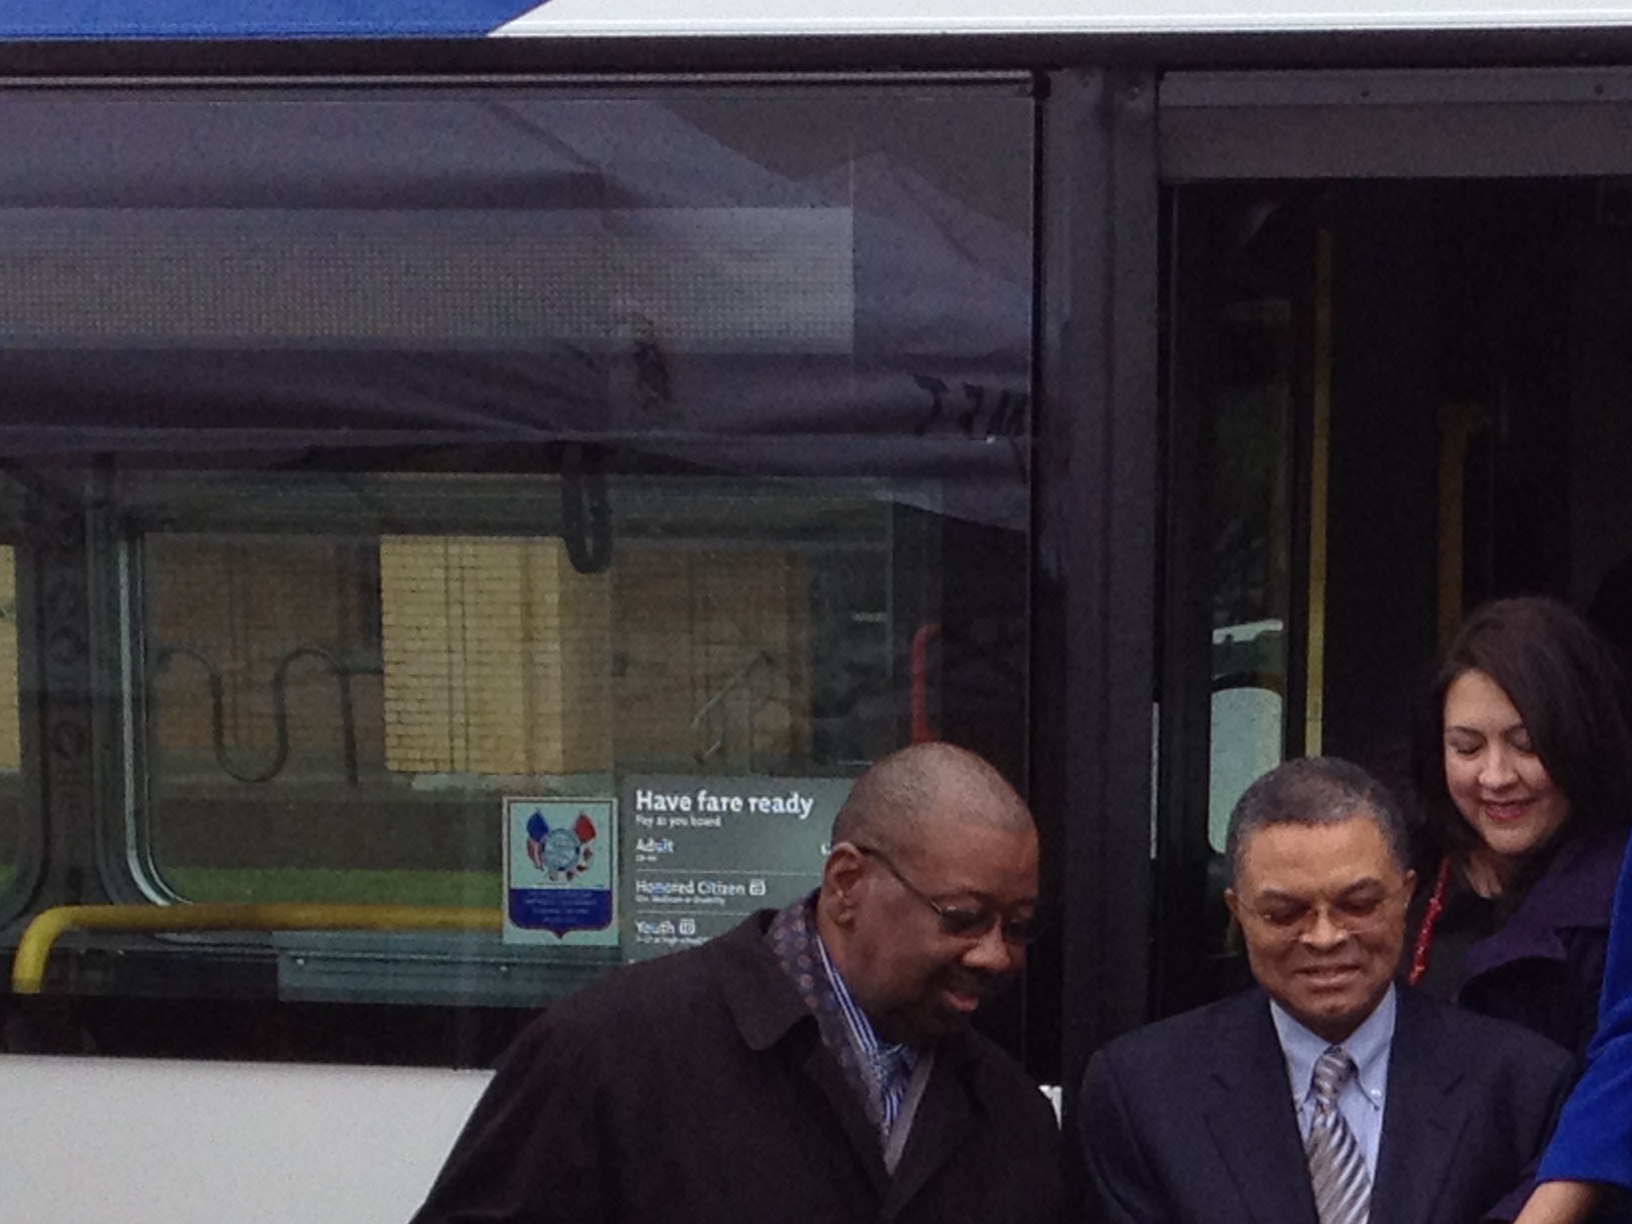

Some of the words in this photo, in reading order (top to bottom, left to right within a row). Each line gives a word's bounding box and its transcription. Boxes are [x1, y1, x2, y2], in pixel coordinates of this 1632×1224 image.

[636, 790, 692, 812] Have
[697, 789, 743, 813] fare
[747, 792, 814, 820] ready
[669, 817, 689, 829] you
[635, 879, 695, 894] Honored
[697, 880, 746, 896] Citizen
[635, 920, 675, 934] Youth
